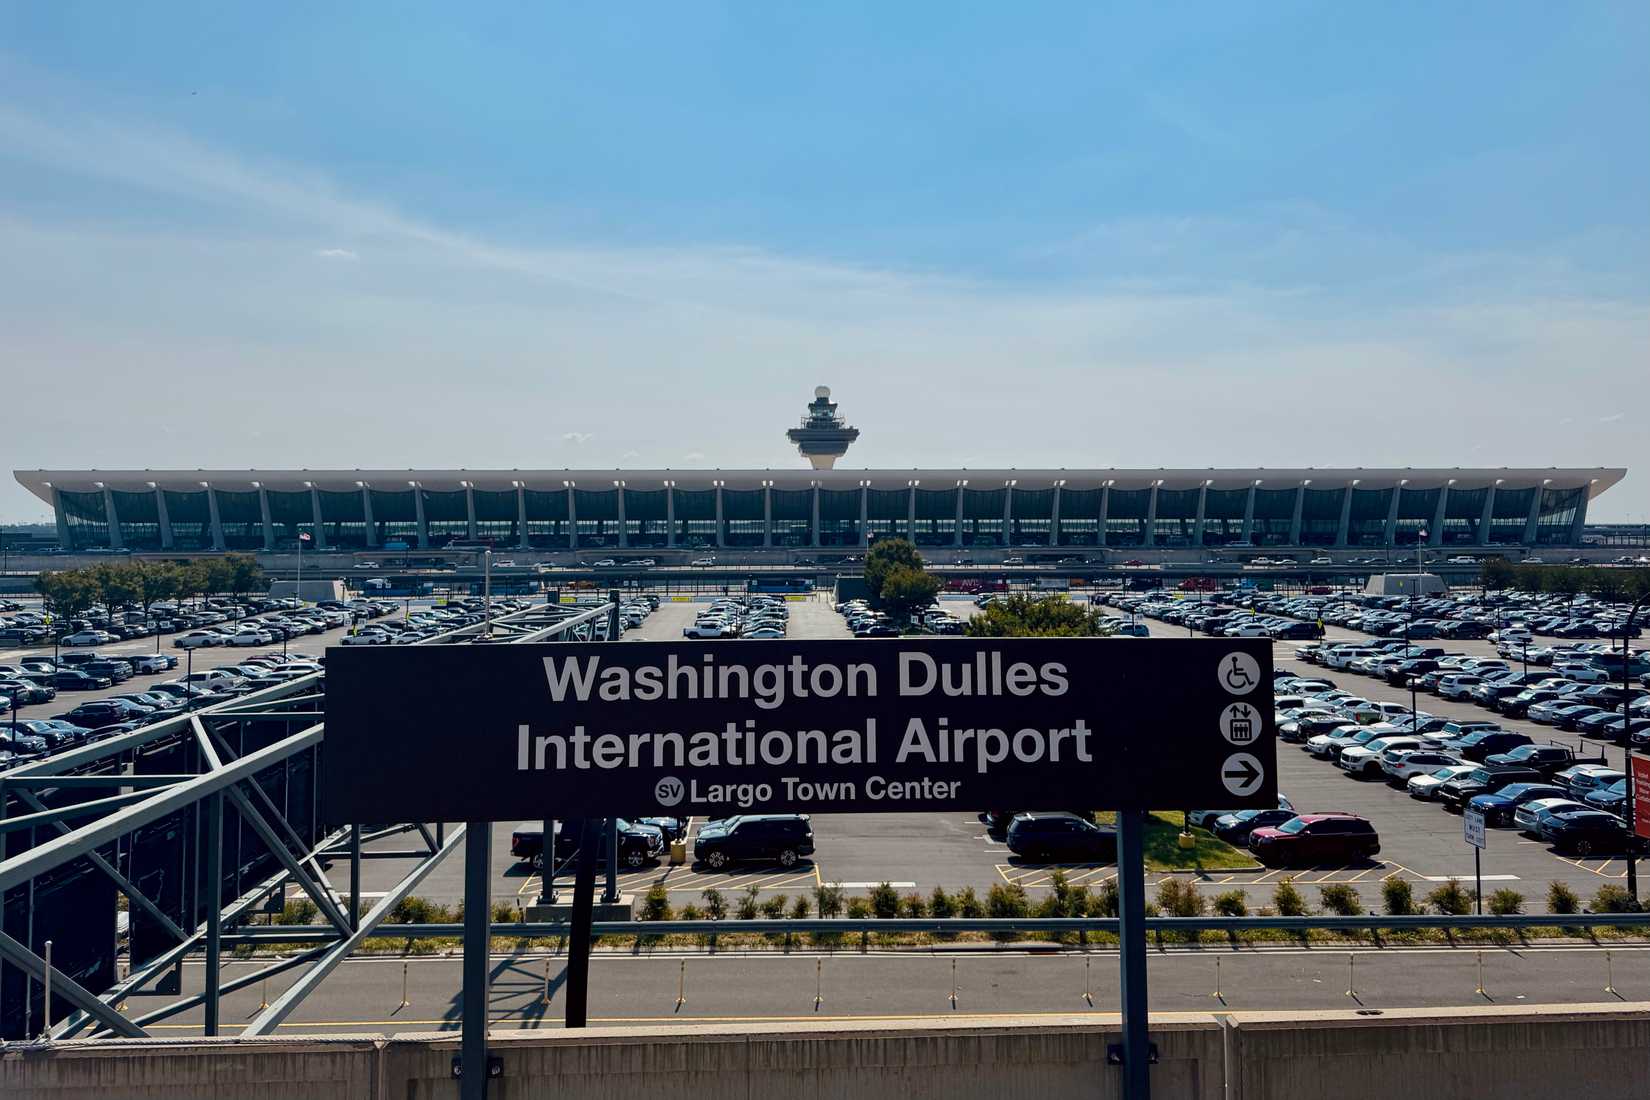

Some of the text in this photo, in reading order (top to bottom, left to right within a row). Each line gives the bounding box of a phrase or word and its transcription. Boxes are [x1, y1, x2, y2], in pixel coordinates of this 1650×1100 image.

[542, 651, 1069, 710] Washington Dulles
[517, 717, 1093, 774] International Airport
[690, 779, 773, 808] Largo
[781, 777, 856, 801] Town
[865, 775, 961, 800] Center
